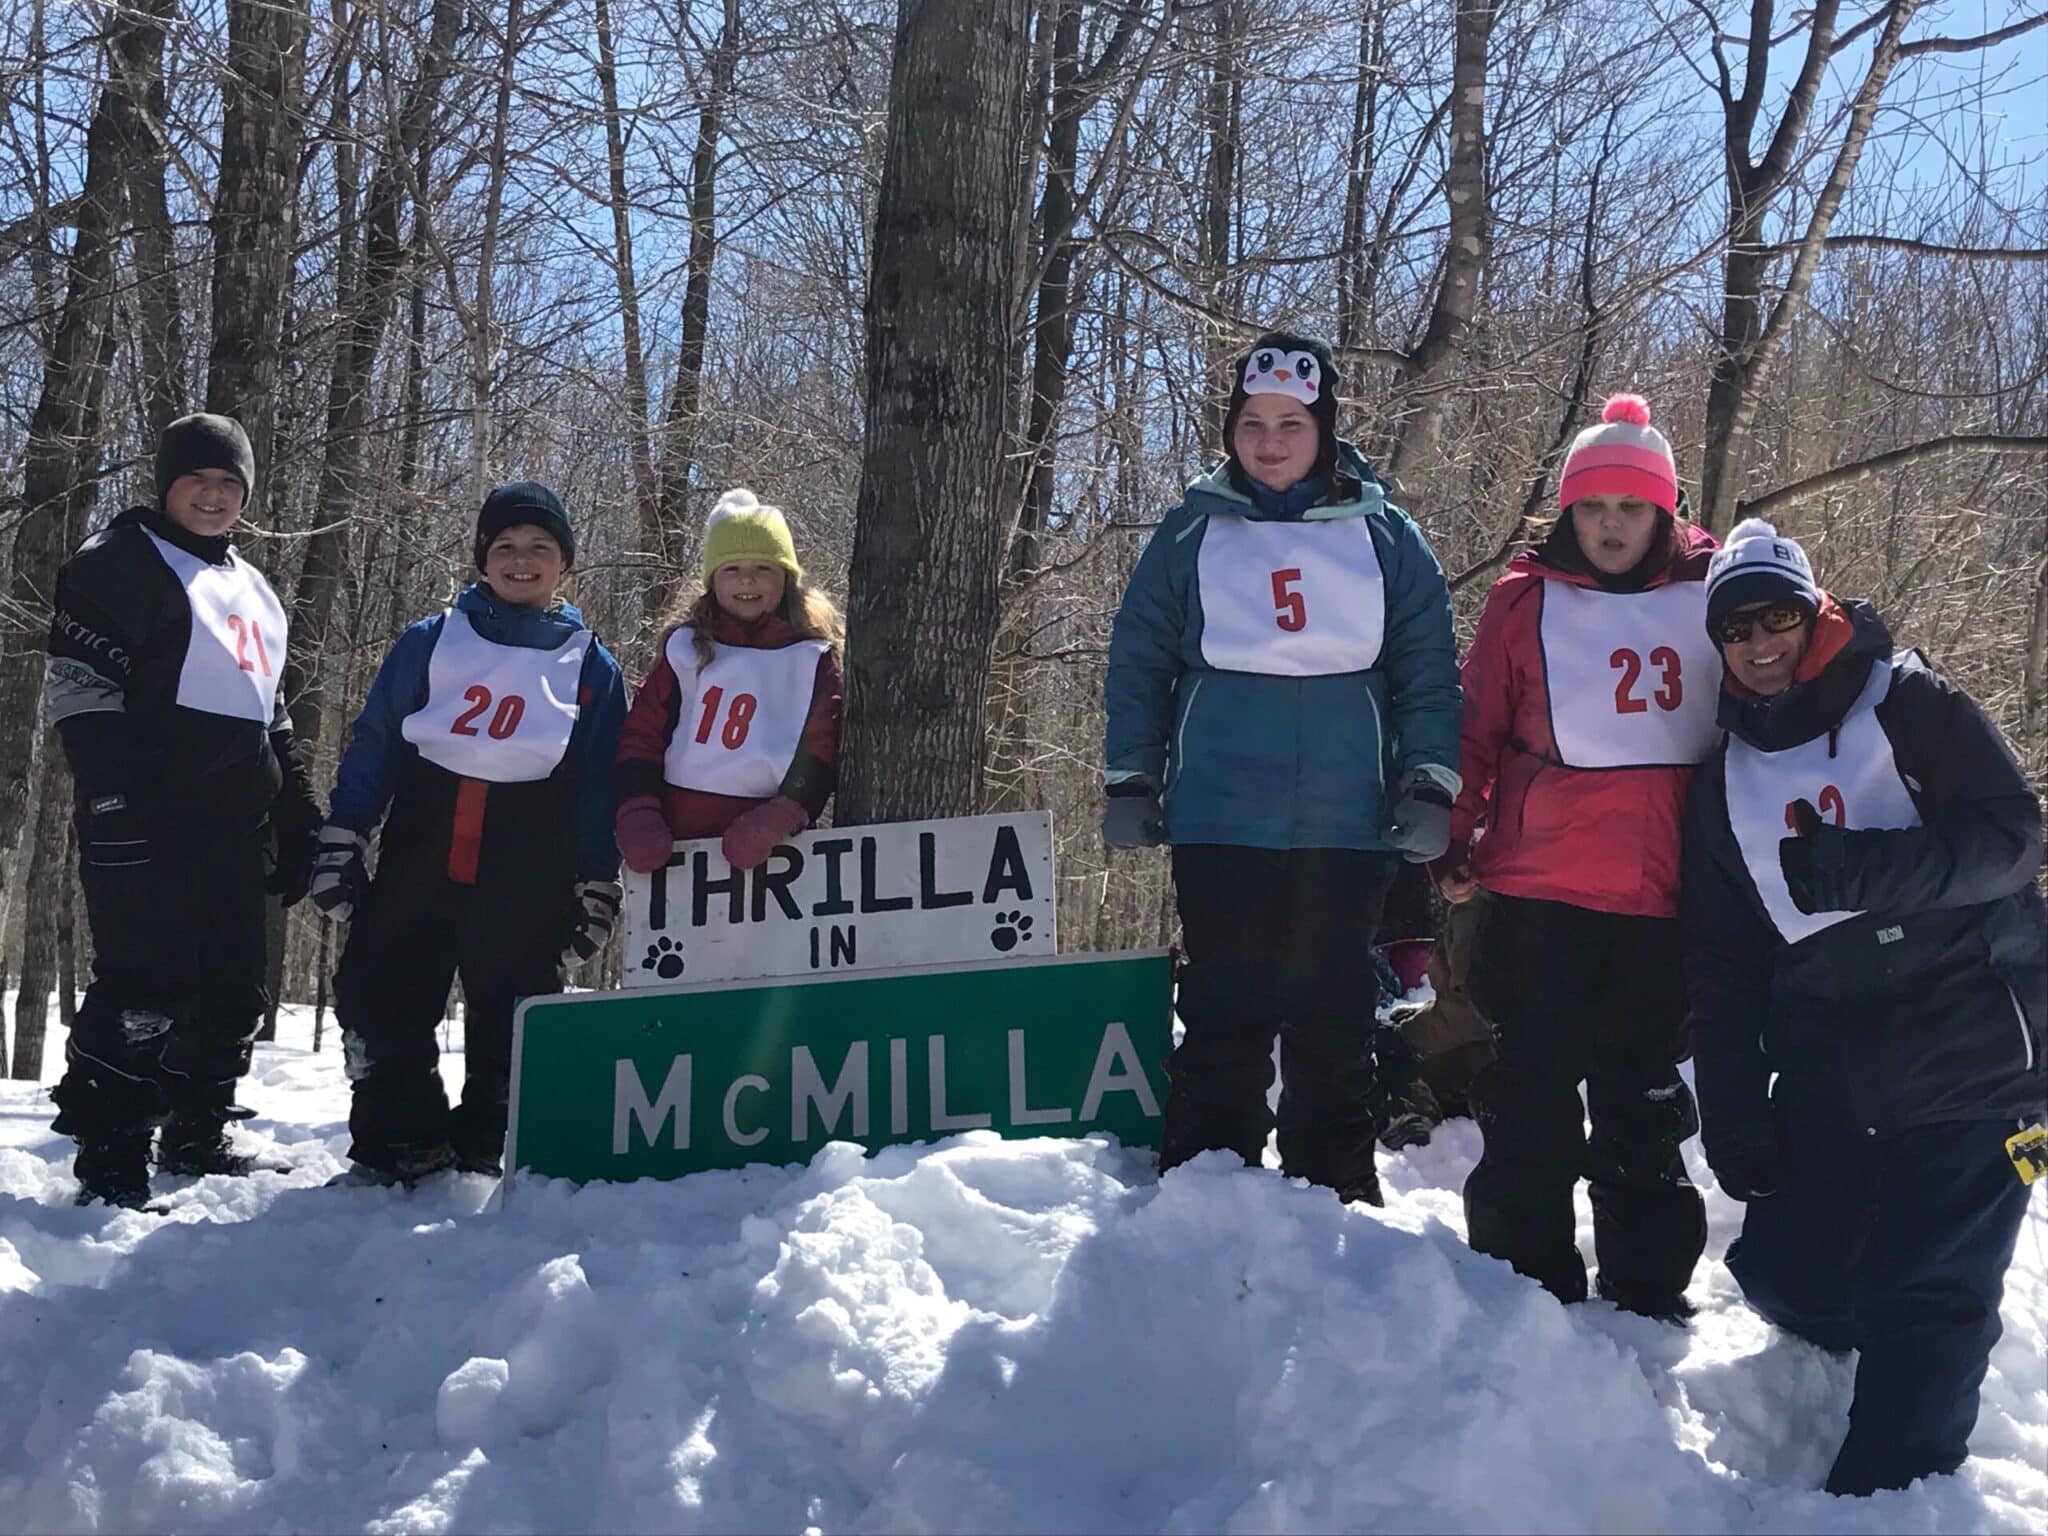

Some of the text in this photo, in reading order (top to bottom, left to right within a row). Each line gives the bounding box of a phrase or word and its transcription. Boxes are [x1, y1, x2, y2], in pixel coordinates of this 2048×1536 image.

[1271, 568, 1307, 632] 5
[227, 613, 273, 677] 21
[450, 684, 526, 740] 20
[1609, 646, 1683, 714] 23
[695, 685, 758, 750] 18
[648, 825, 1034, 931] THRILLA
[810, 924, 857, 969] IN
